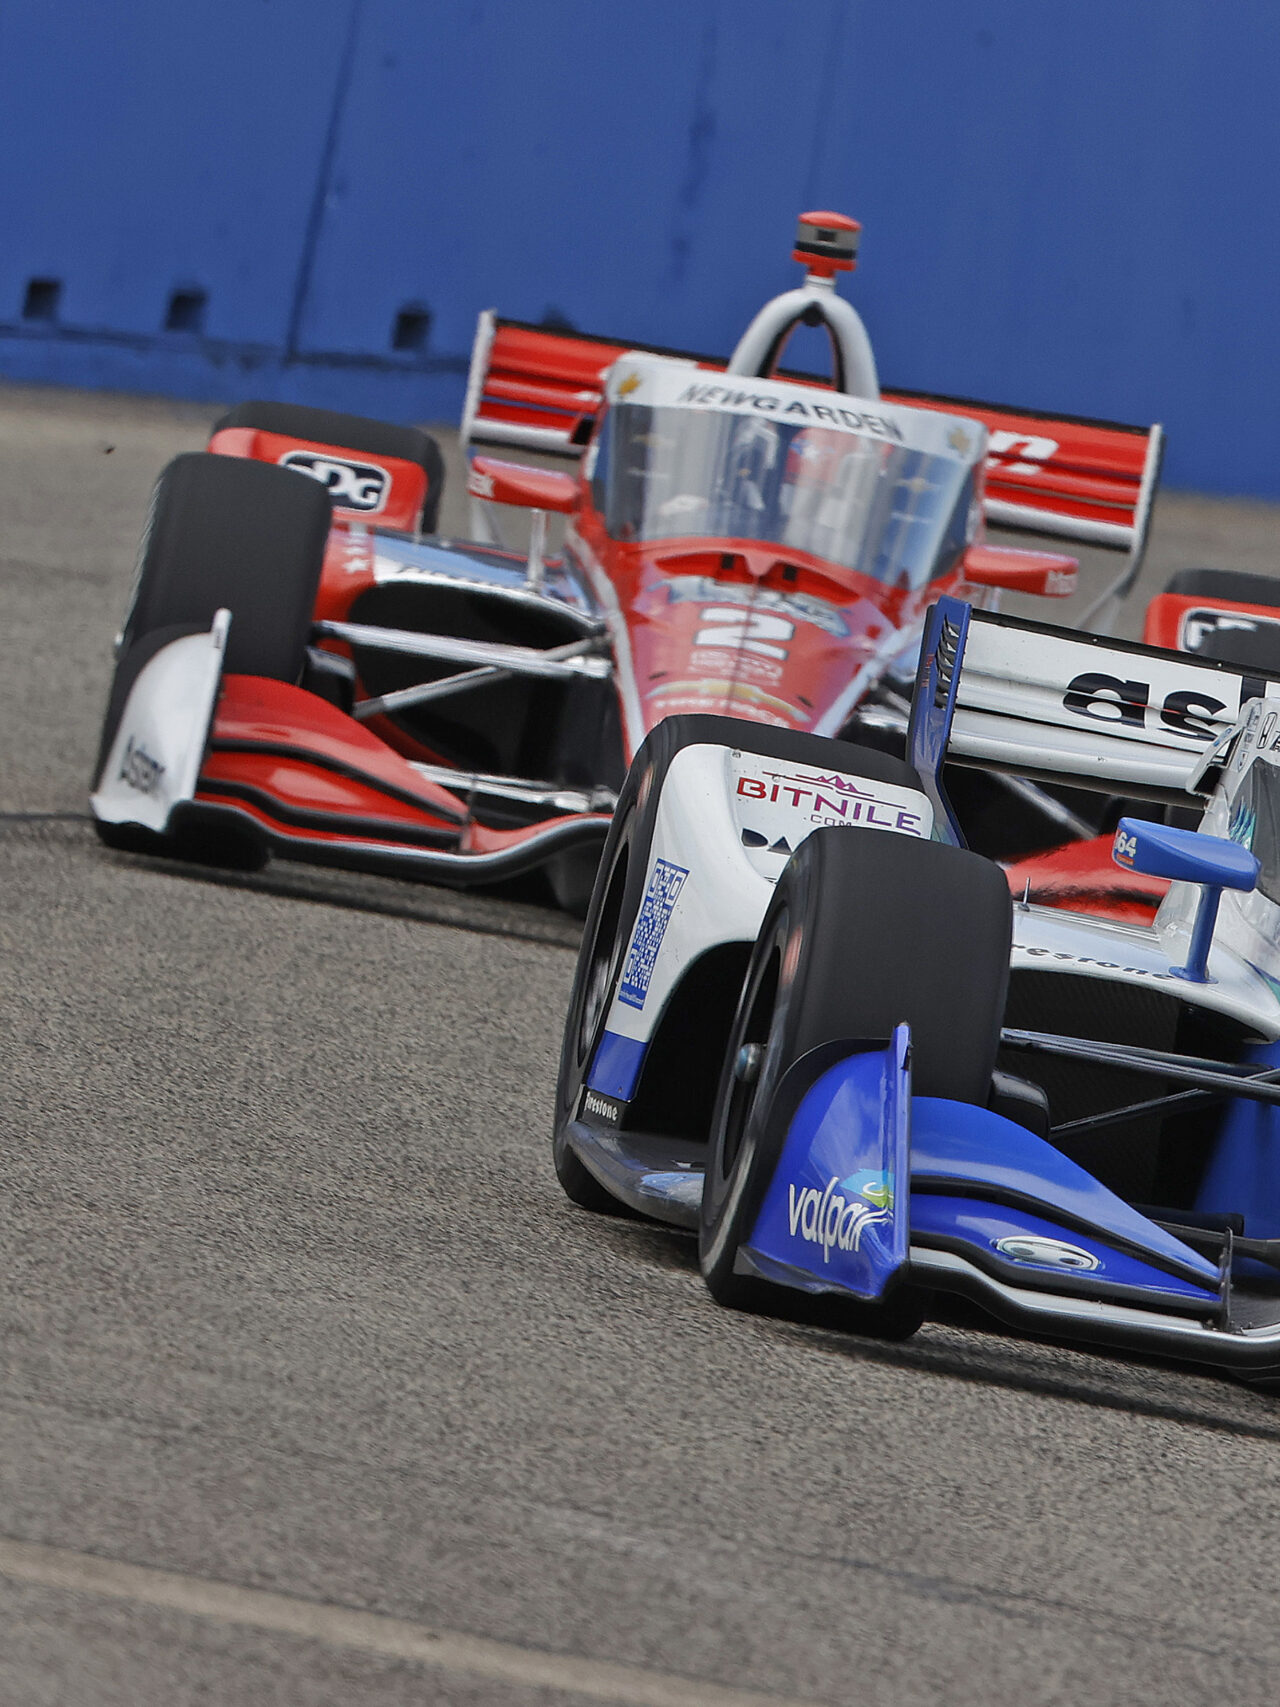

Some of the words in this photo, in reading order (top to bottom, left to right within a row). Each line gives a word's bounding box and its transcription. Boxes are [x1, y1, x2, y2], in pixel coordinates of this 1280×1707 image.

[678, 383, 905, 441] NEWGARDEN
[694, 607, 796, 661] 2
[736, 777, 922, 836] BITNILE
